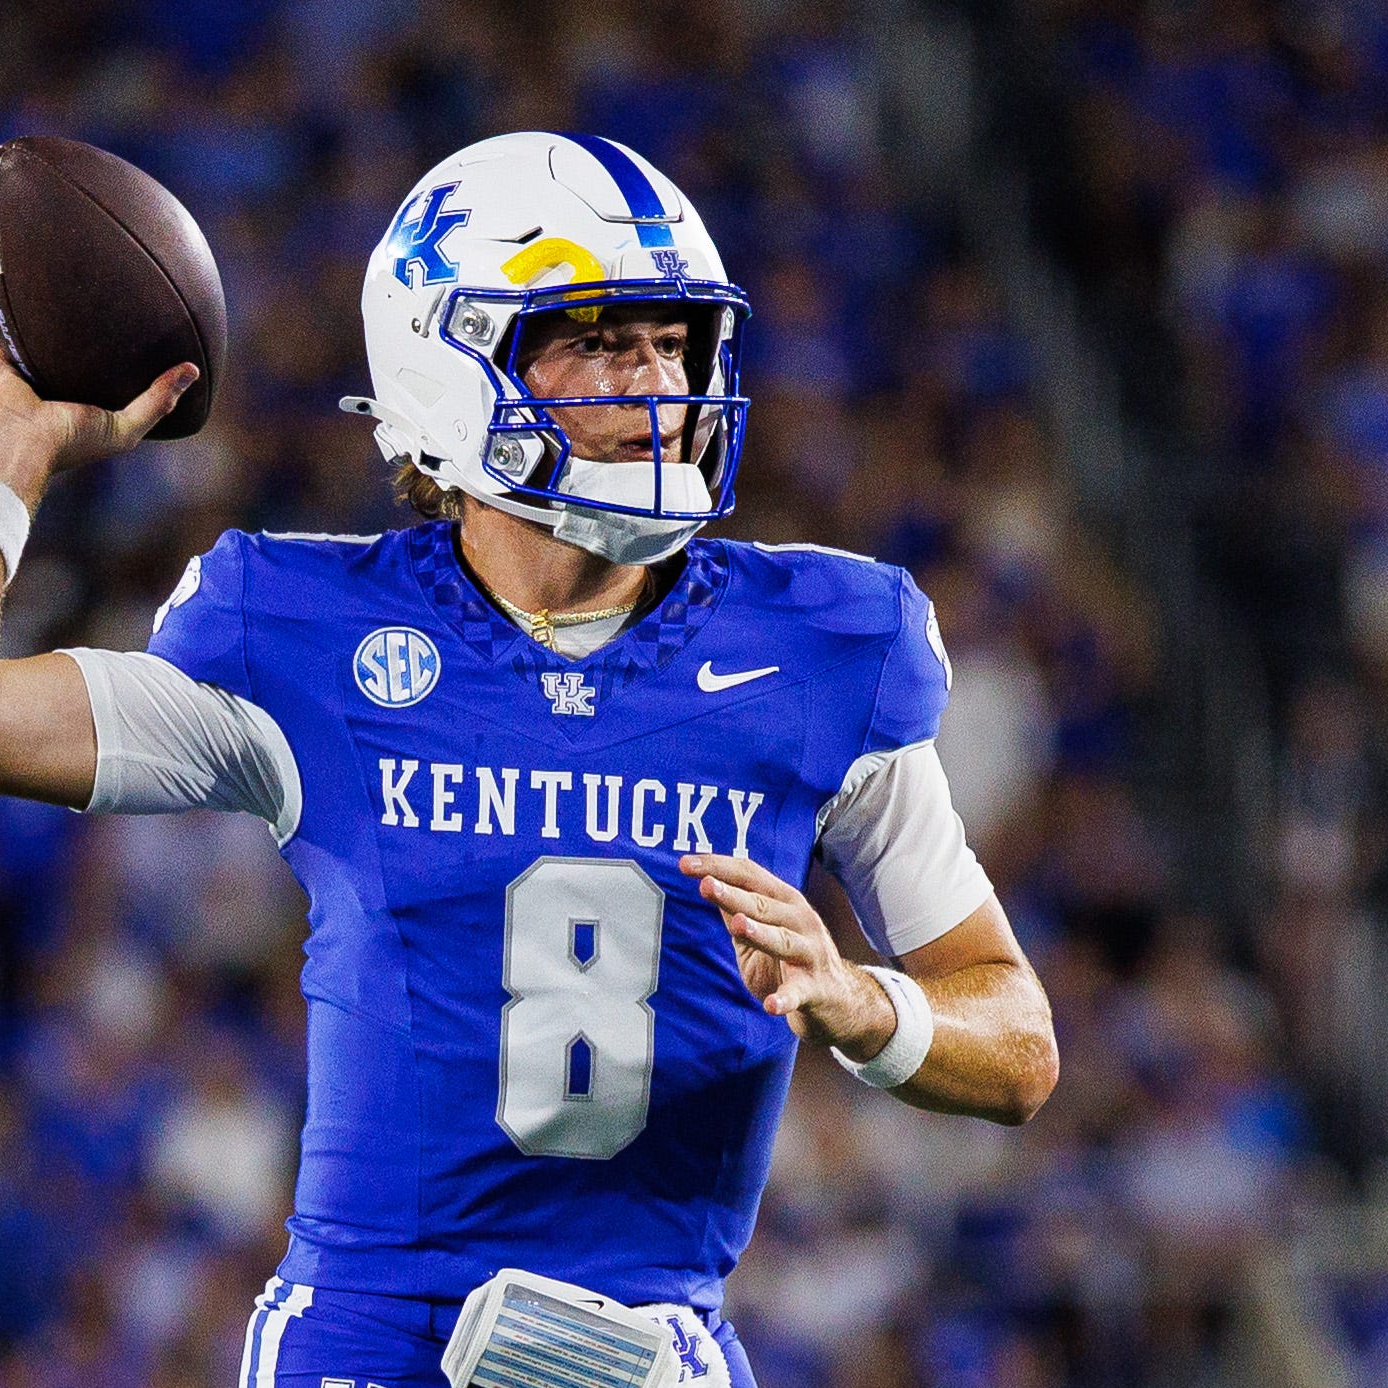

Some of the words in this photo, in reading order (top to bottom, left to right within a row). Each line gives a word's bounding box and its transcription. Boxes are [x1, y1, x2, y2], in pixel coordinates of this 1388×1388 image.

[386, 180, 472, 288] UK
[650, 249, 691, 279] UK
[359, 632, 435, 703] SEC
[541, 672, 596, 716] UK
[378, 758, 764, 859] KENTUCKY
[495, 855, 666, 1161] 8
